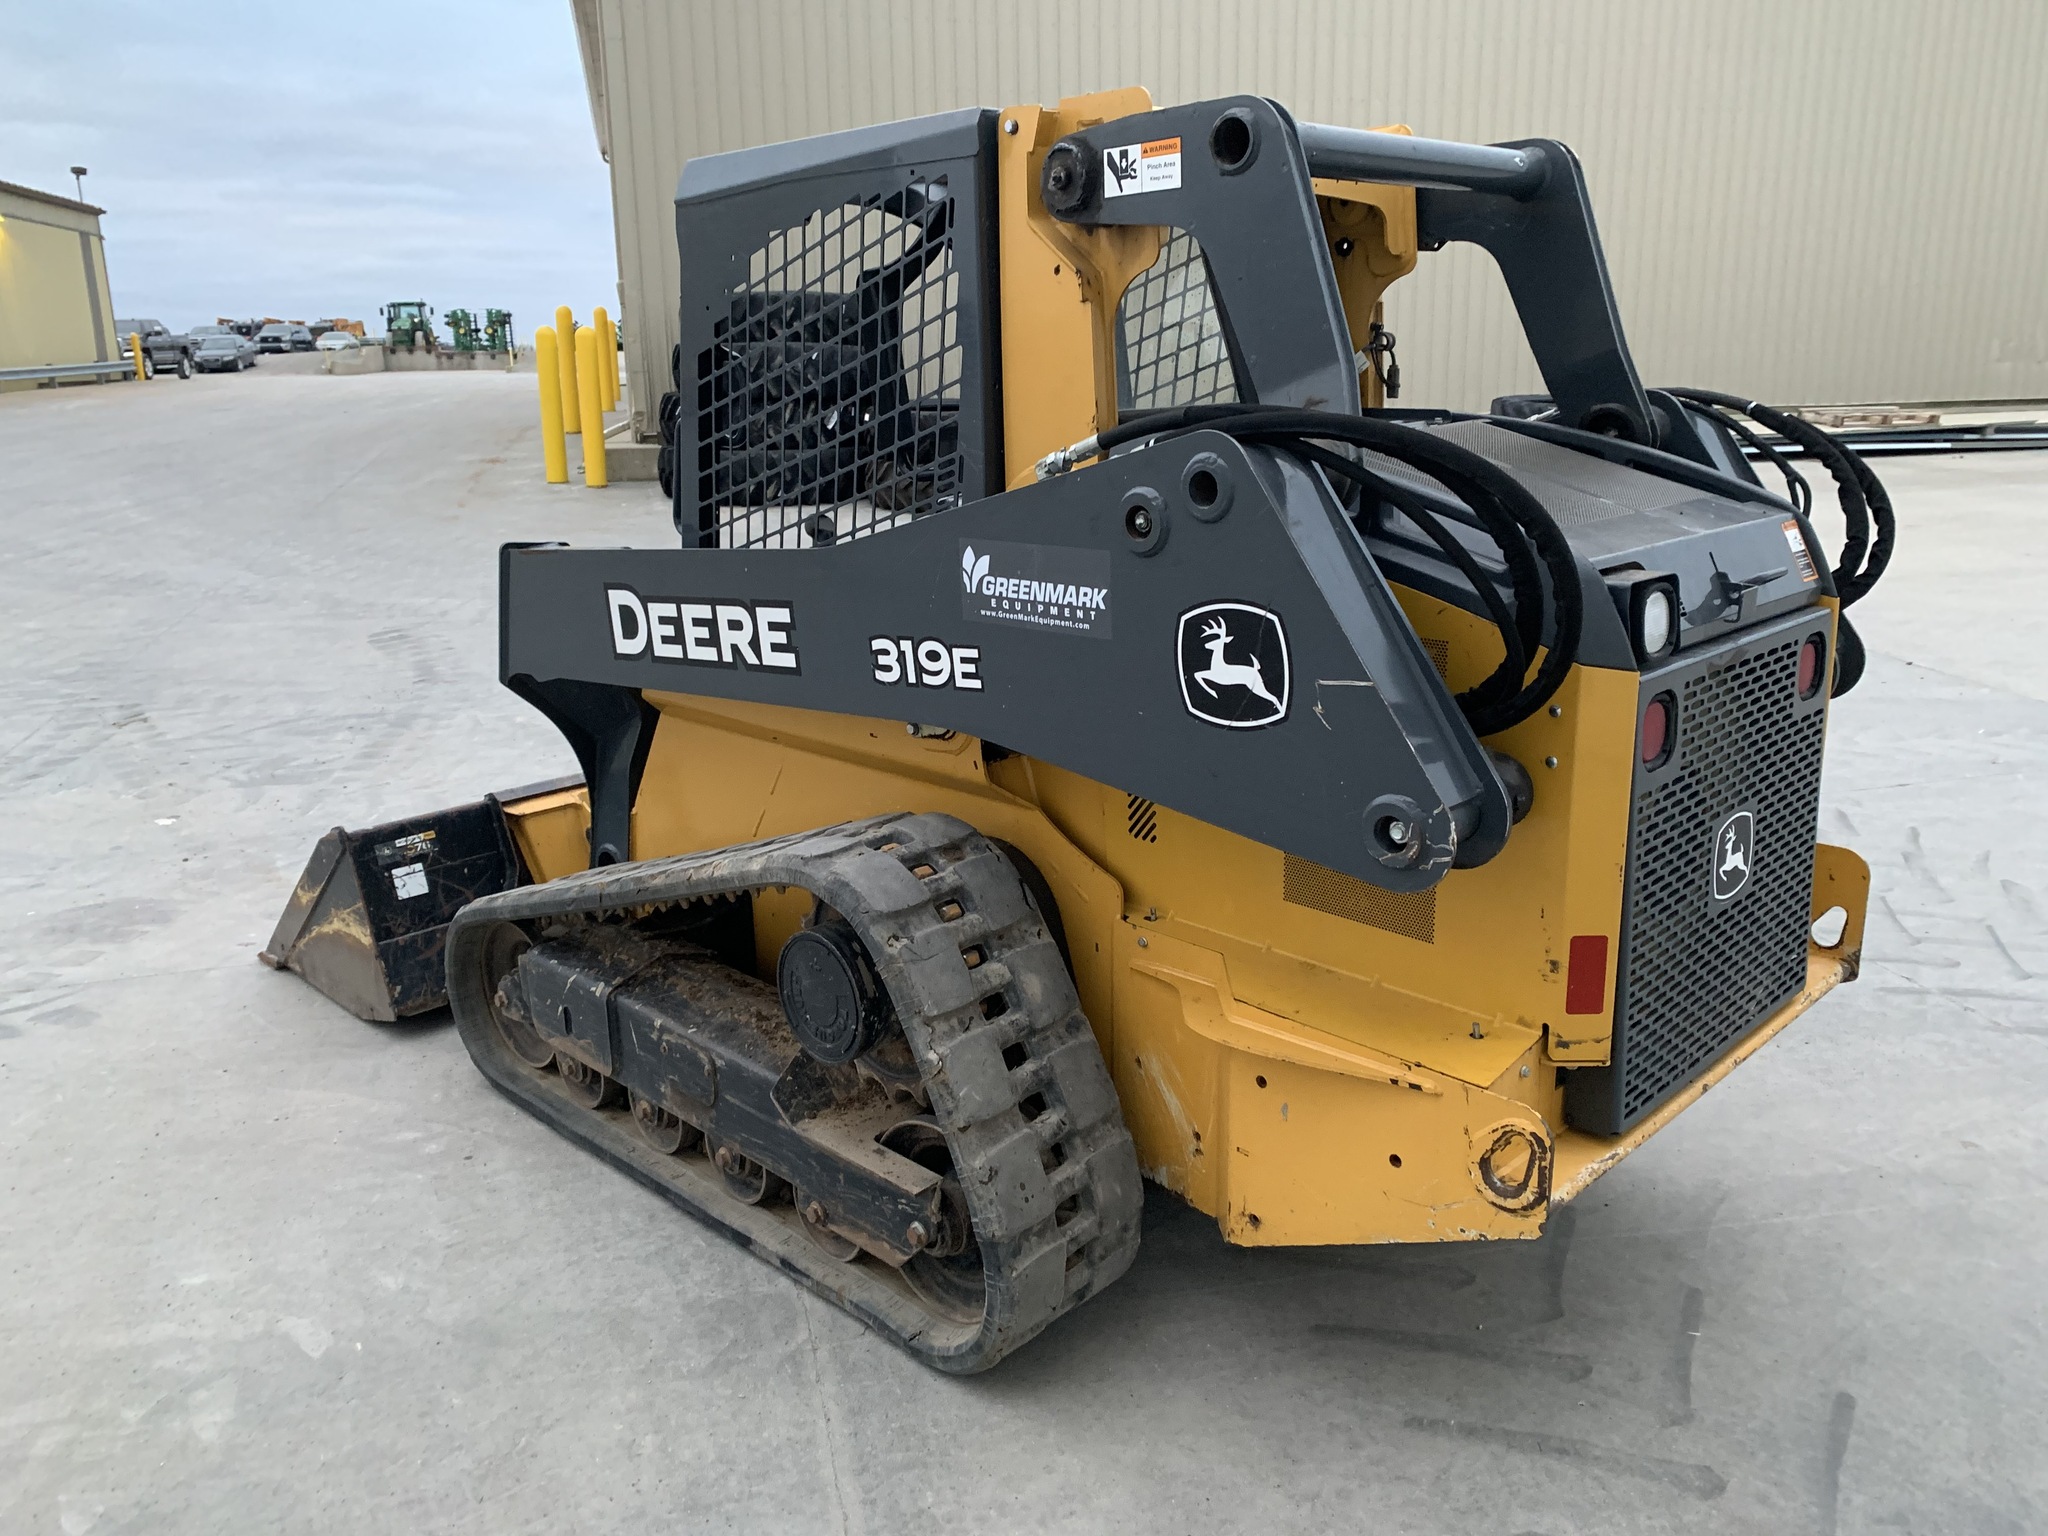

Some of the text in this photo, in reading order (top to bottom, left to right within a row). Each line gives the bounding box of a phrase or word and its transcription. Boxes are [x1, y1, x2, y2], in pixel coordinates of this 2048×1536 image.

[1150, 143, 1177, 152] WARNING
[981, 575, 1109, 610] GREENMARK
[980, 608, 1090, 631] www.GreenMarkEquipment.com
[990, 598, 1096, 621] EQUIPMENT
[607, 588, 797, 669] DEERE
[870, 637, 983, 690] 319E
